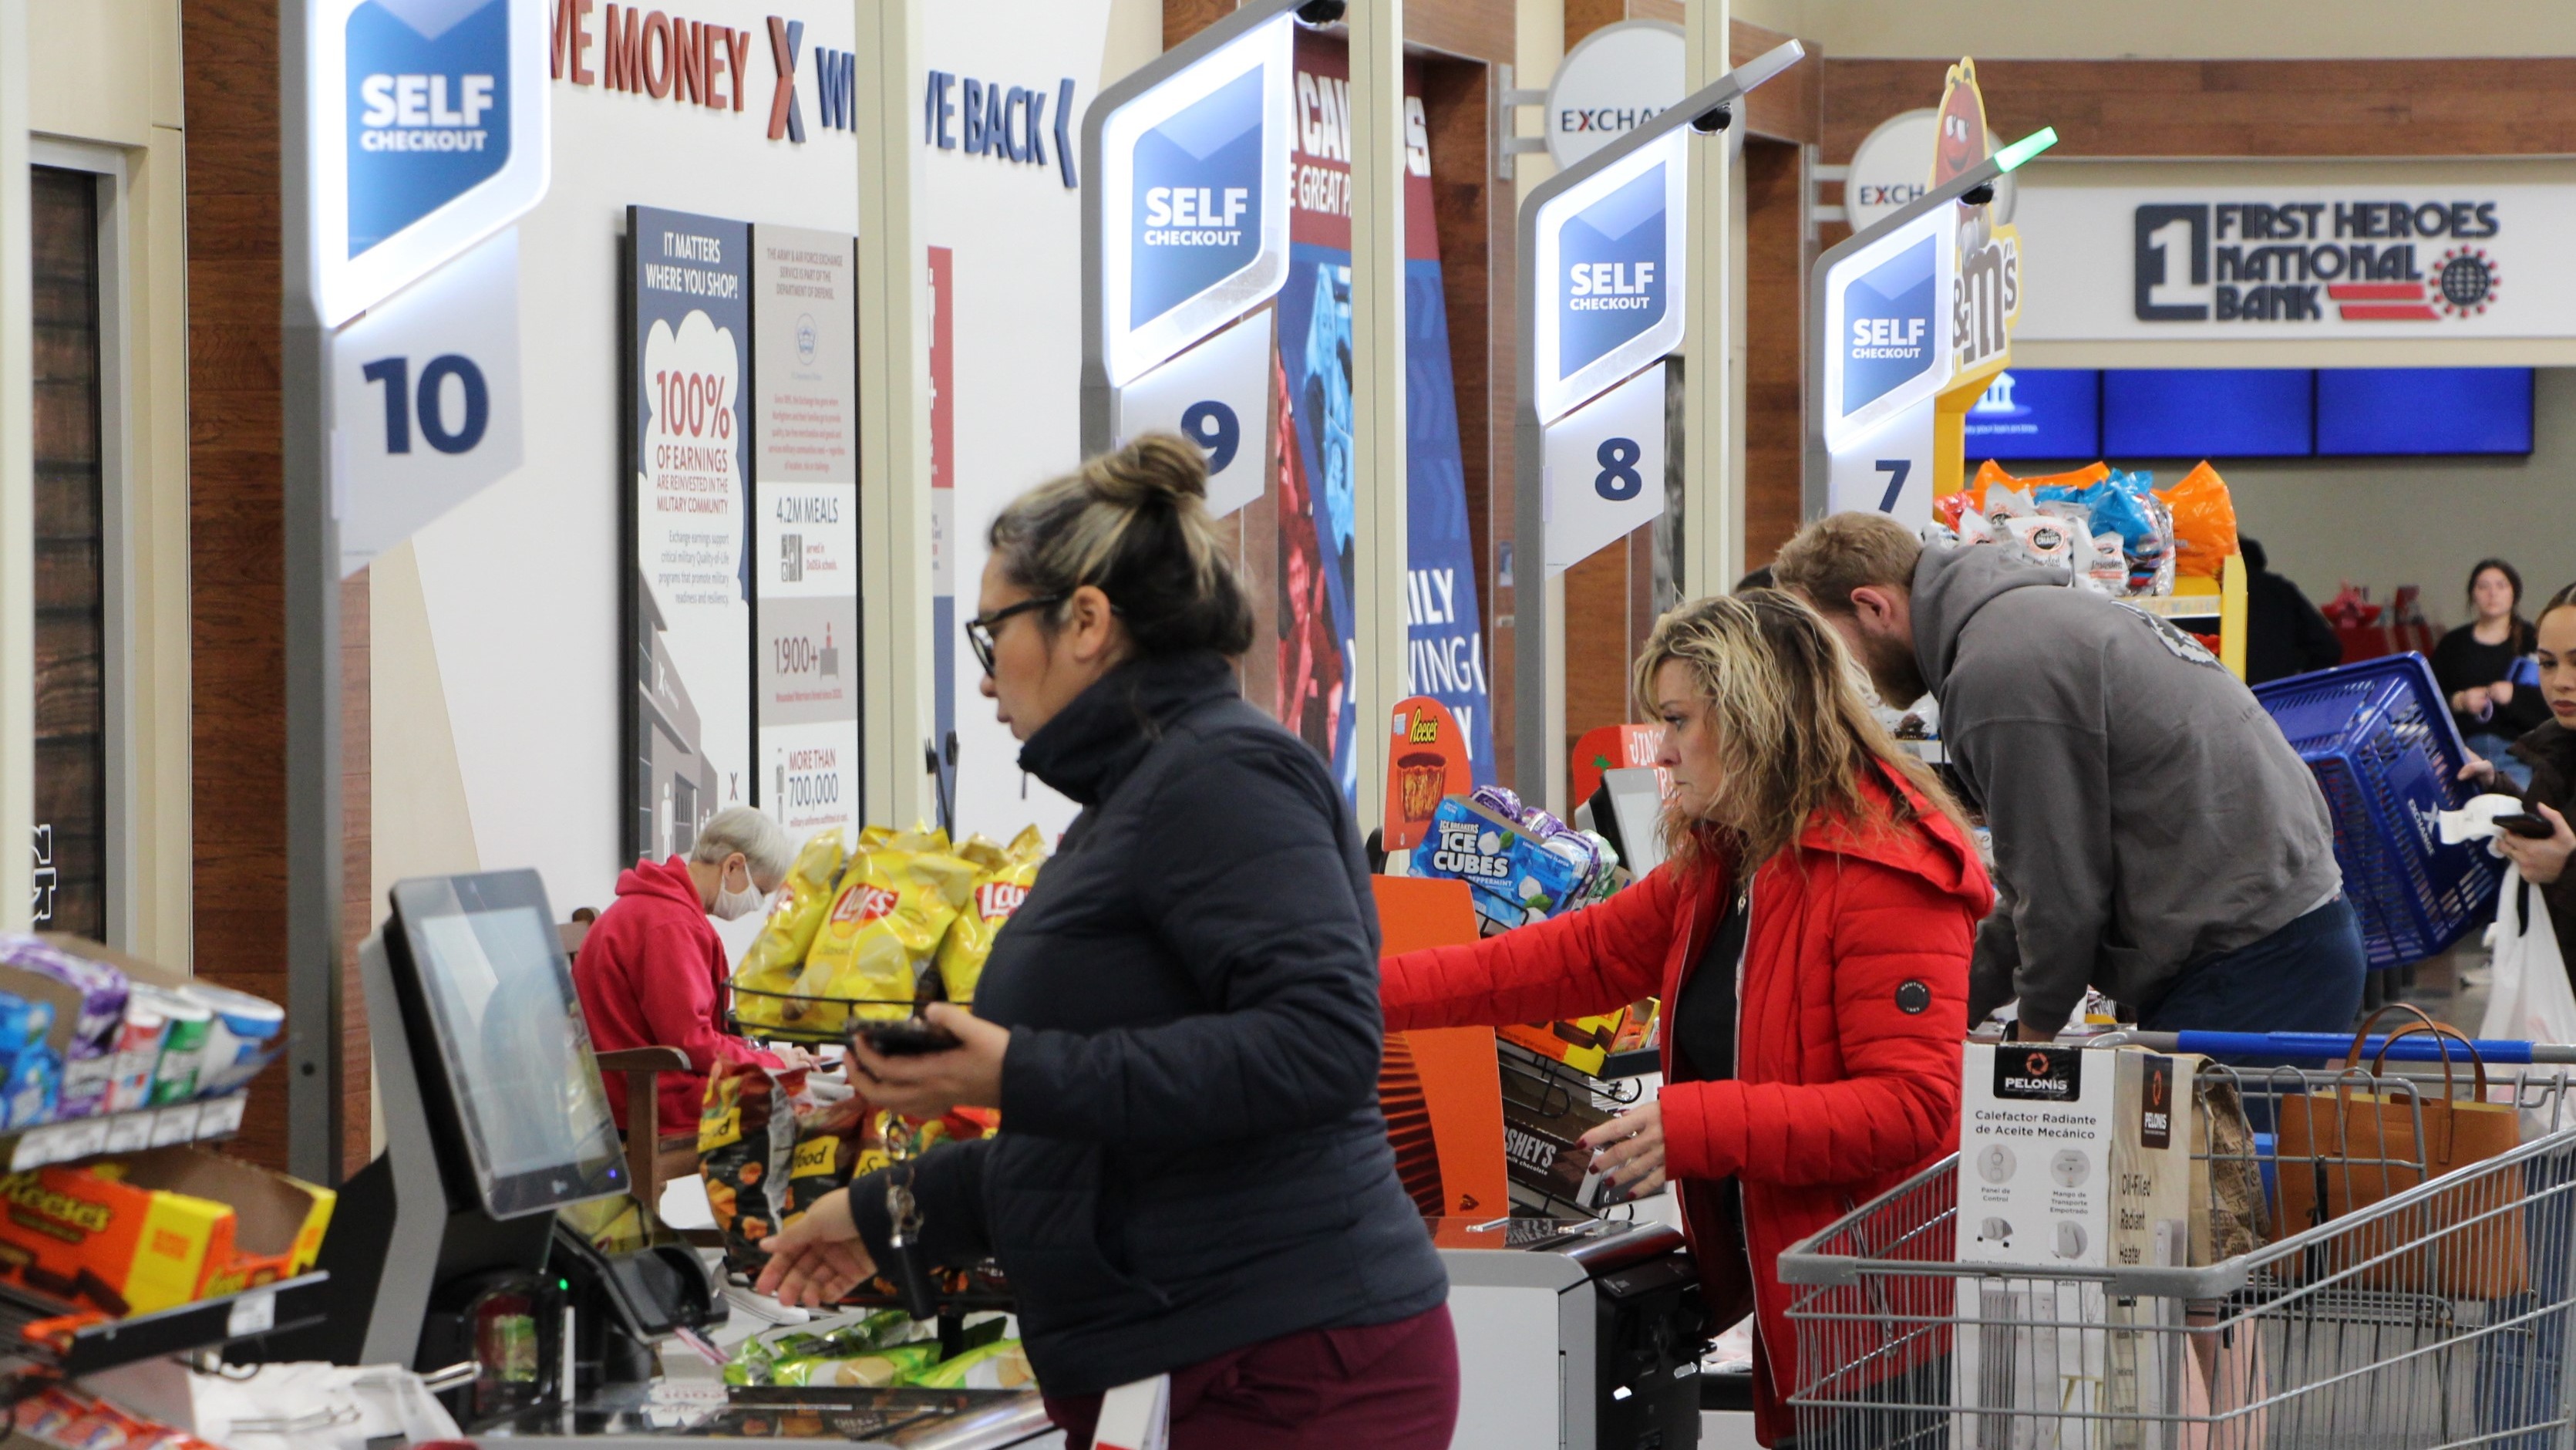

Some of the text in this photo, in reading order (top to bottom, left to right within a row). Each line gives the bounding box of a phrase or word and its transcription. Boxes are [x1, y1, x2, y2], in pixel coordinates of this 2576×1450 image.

[604, 3, 750, 112] MONEY
[815, 46, 856, 133] W
[964, 77, 1048, 165] BACK
[361, 74, 493, 127] SELF
[1561, 107, 1668, 132] EXCHA
[360, 130, 487, 152] CHECKOUT
[1300, 164, 1343, 215] GREAT
[1860, 184, 1925, 205] EXCH
[1145, 187, 1248, 228] SELF
[2217, 201, 2500, 241] FIRST HEROES
[664, 231, 721, 264] IT MATTERS
[1144, 231, 1241, 246] CHECKOUT
[2217, 243, 2423, 282] NATIONAL
[646, 263, 738, 299] WHERE YOU SHOP!
[1571, 261, 1654, 295] SELF
[1570, 296, 1650, 310] CHECKOUT
[2216, 284, 2322, 321] BANK
[1853, 318, 1925, 346] SELF
[1852, 346, 1921, 359] CHECKOUT
[362, 354, 490, 455] 10
[657, 370, 731, 440] 100%
[1181, 400, 1240, 477] 9
[657, 444, 728, 473] OF EARNINGS
[1594, 438, 1642, 501] 8
[657, 474, 728, 494] ARE REINVESTED IN THE
[1875, 460, 1911, 513] 7
[657, 496, 729, 514] MILITARY COMMUNITY
[776, 497, 839, 524] 4.2M MEALS
[774, 636, 818, 676] 1,900+
[1409, 706, 1438, 745] Reese's
[790, 748, 836, 771] MORE THAN
[789, 773, 839, 811] 700,000
[1440, 820, 1479, 834] ICE BREAKERS
[1440, 831, 1477, 855] ICE
[1433, 850, 1509, 878] CUBES
[2005, 1077, 2068, 1091] PELONIS
[1975, 1110, 2096, 1126] Calefactor Radiante
[2144, 1111, 2167, 1130] PELONIS
[1975, 1125, 2096, 1140] de Aceite Mecánico
[1504, 1126, 1557, 1168] SHEY'S
[1519, 1161, 1548, 1177] chocolate
[2053, 1190, 2076, 1199] Mango
[2049, 1206, 2089, 1215] Empotrado
[2120, 1208, 2145, 1231] Radiant
[2119, 1243, 2141, 1266] Heater
